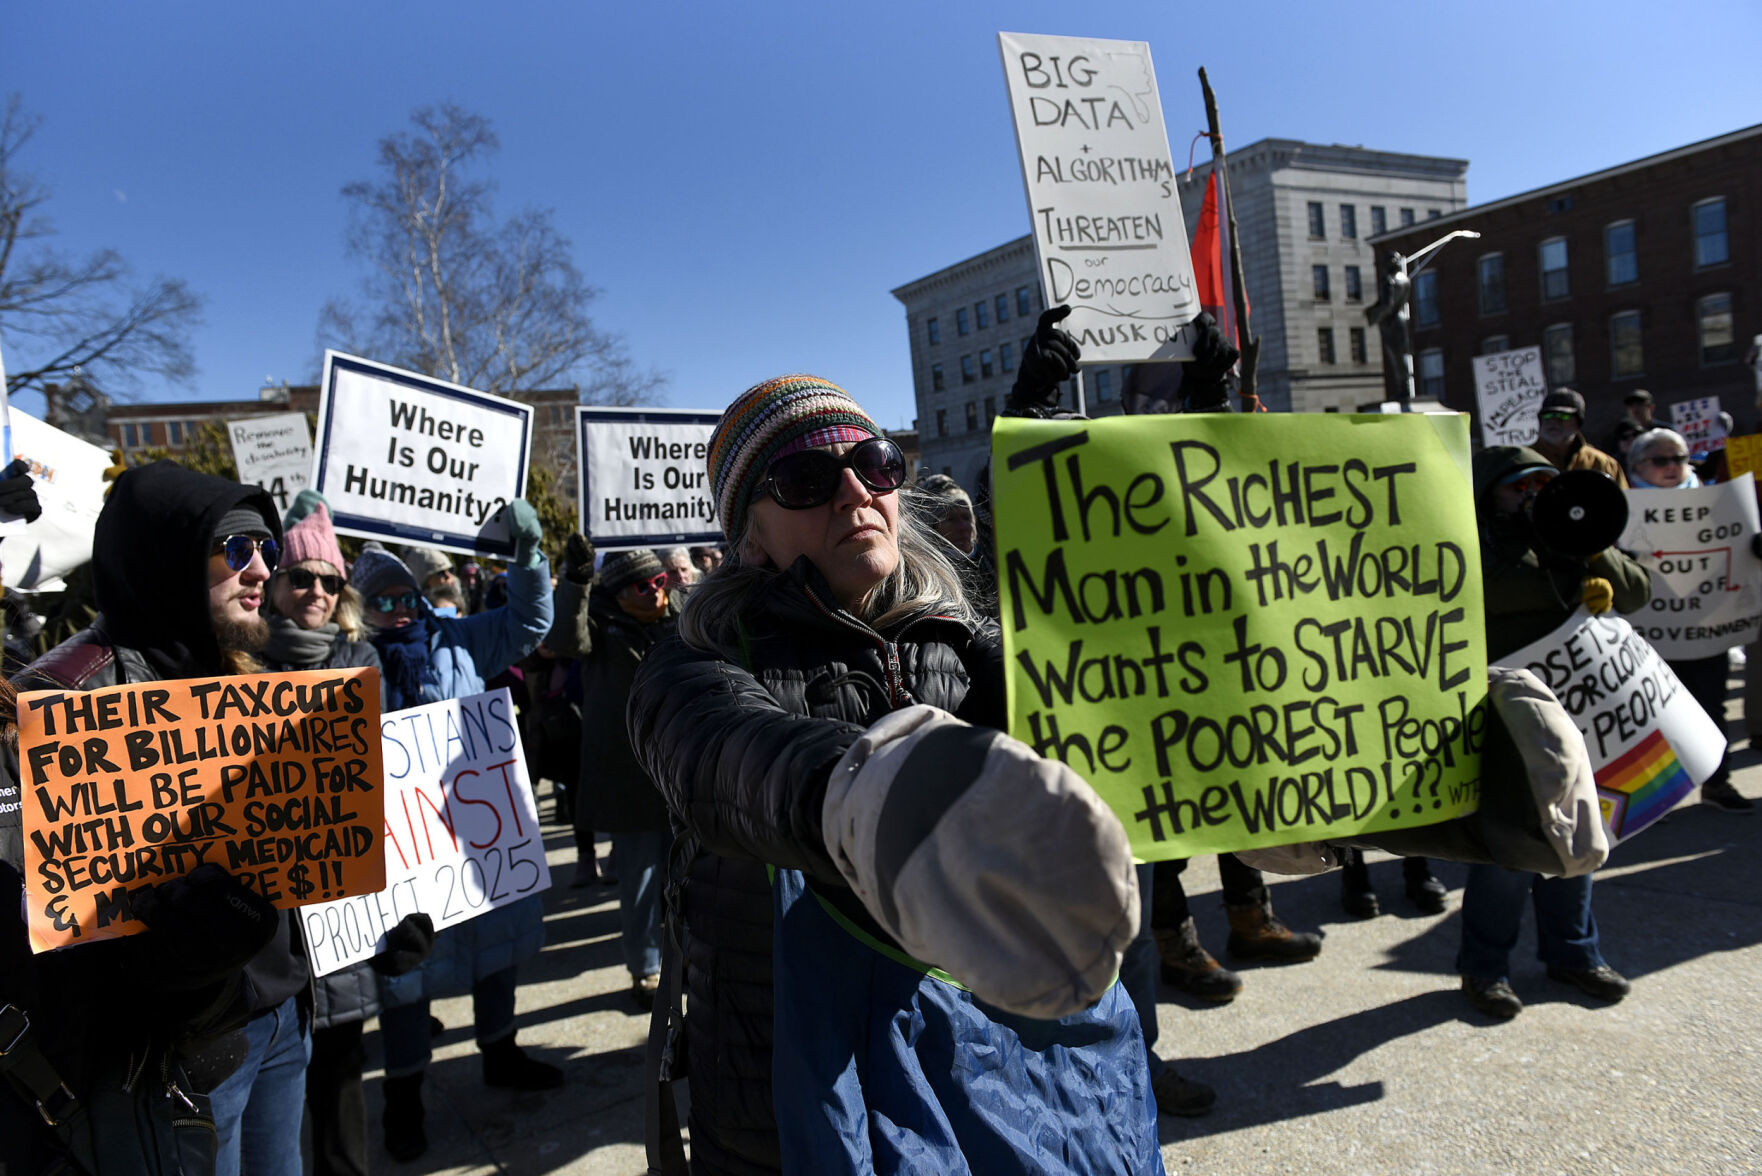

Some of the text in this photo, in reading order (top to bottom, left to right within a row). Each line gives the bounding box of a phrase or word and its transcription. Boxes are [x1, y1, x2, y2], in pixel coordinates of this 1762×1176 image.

[1020, 52, 1098, 88] BIG
[1029, 96, 1134, 131] DATA
[1038, 206, 1164, 244] THREATEN
[1084, 256, 1109, 268] our
[1046, 257, 1193, 309] Democracy
[1066, 322, 1147, 347] MUSK
[1153, 321, 1192, 346] OUT
[1486, 351, 1537, 373] STOP
[1485, 375, 1541, 396] STEAL
[389, 398, 484, 448] Where
[388, 437, 480, 482] Is Our
[629, 436, 706, 460] Where
[344, 464, 507, 526] Humanity?
[634, 466, 705, 490] Is Our
[1007, 430, 1417, 542] The RICHEST
[604, 496, 717, 523] Humanity
[1644, 507, 1711, 523] KEEP
[1697, 522, 1743, 544] GOD
[1004, 531, 1467, 633] Man in the WORLD
[1659, 558, 1711, 574] OUT
[1699, 576, 1728, 595] OF
[1651, 596, 1702, 612] OUR
[1016, 607, 1472, 708] Wants to STARVE
[28, 677, 363, 736] THEIR TAXCUTS
[27, 715, 369, 786] FOR BILLIONAIRES
[1026, 691, 1485, 778] the POOREST People
[35, 757, 375, 823] WILL BE PAID FOR
[30, 795, 358, 860] WITH OUR SOCIAL
[1134, 781, 1233, 842] the
[37, 824, 374, 895] SECURITY MEDICAID
[44, 894, 82, 938] &
[306, 838, 540, 972] PROJECT 2025
